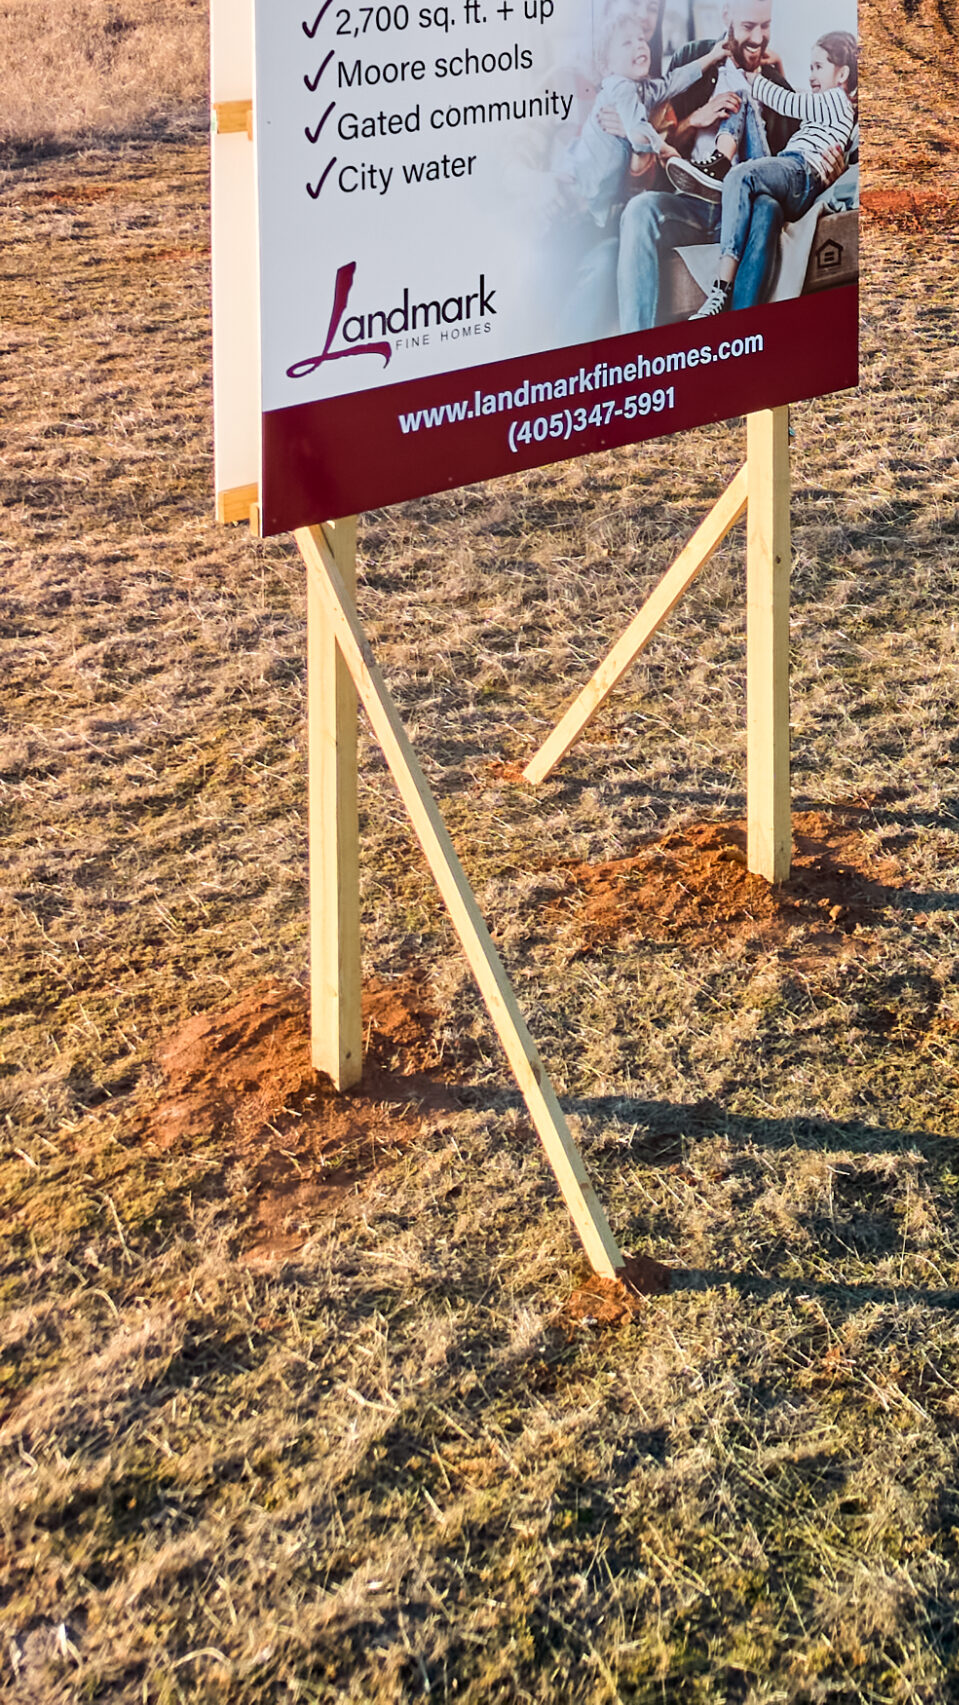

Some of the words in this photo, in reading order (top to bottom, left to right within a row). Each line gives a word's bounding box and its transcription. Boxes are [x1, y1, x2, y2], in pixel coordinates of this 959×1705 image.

[336, 4, 409, 38] 2,700
[418, 6, 455, 33] sq.
[337, 59, 426, 88] Moore
[434, 43, 533, 78] schools
[337, 104, 420, 140] Gated
[430, 89, 574, 129] community
[338, 162, 393, 195] City
[402, 154, 477, 184] water
[286, 261, 497, 378] Landmark
[395, 334, 431, 350] FINE
[440, 321, 492, 343] HOMES
[398, 333, 764, 434] www.landmarkfinehomes.com
[508, 386, 676, 453] (405)347-5991
